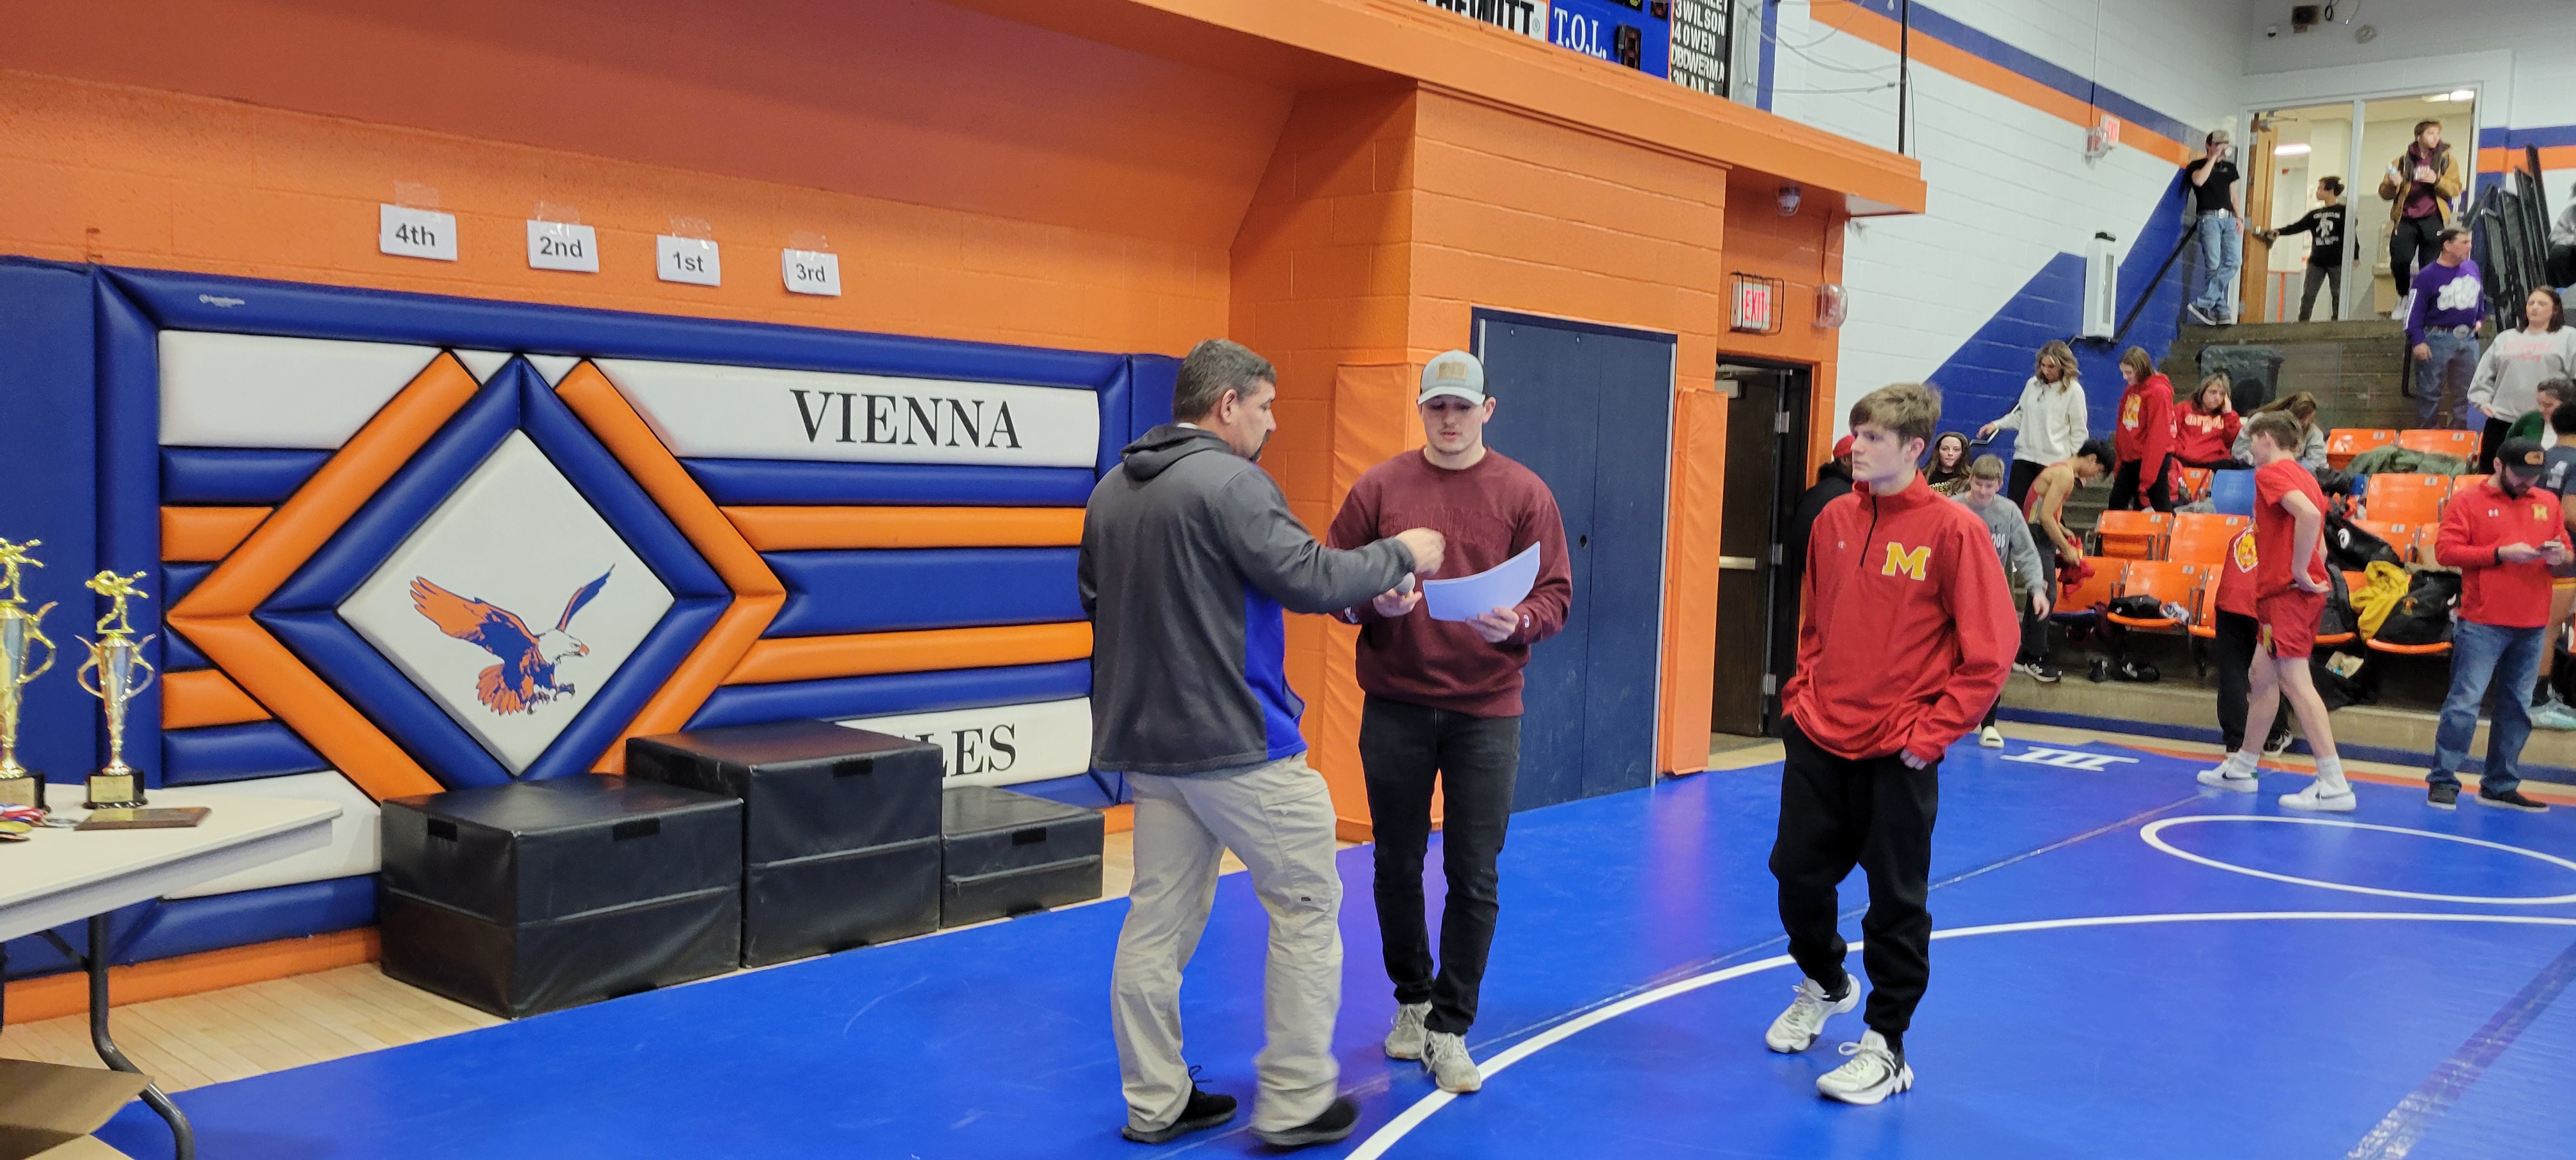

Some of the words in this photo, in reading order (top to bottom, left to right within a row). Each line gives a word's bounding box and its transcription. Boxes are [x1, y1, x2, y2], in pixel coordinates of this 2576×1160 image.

[1554, 7, 1607, 59] T.O.L.
[395, 224, 436, 248] 4th
[539, 235, 583, 259] 2nd
[673, 252, 705, 273] 1st
[796, 264, 826, 284] 3rd
[1744, 289, 1767, 322] EXIT
[789, 388, 1023, 450] VIENNA
[1881, 541, 1931, 581] M
[916, 722, 1016, 778] ES
